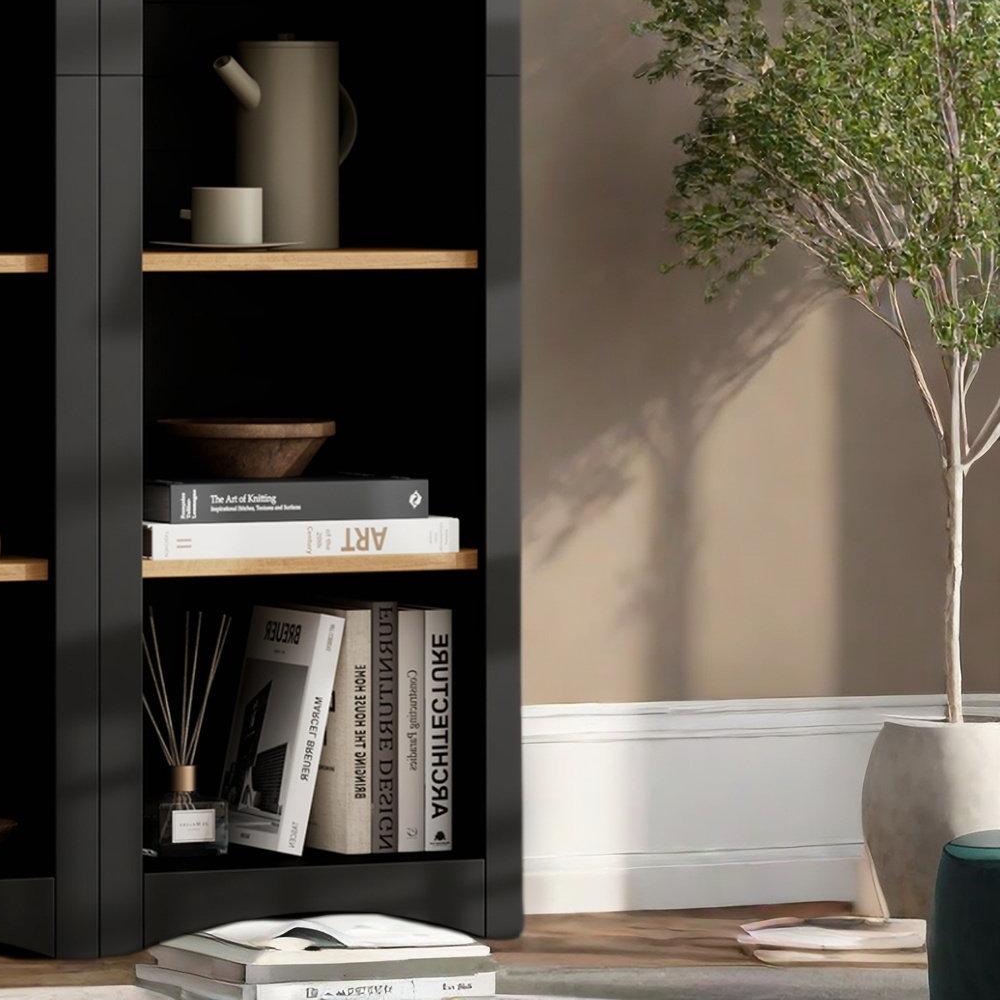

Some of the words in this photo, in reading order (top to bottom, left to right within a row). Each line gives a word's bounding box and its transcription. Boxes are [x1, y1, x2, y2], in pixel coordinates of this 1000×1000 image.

[210, 494, 225, 504] The
[225, 494, 238, 504] Art
[238, 494, 247, 503] of
[247, 493, 277, 505] Knitting
[341, 526, 388, 552] ART
